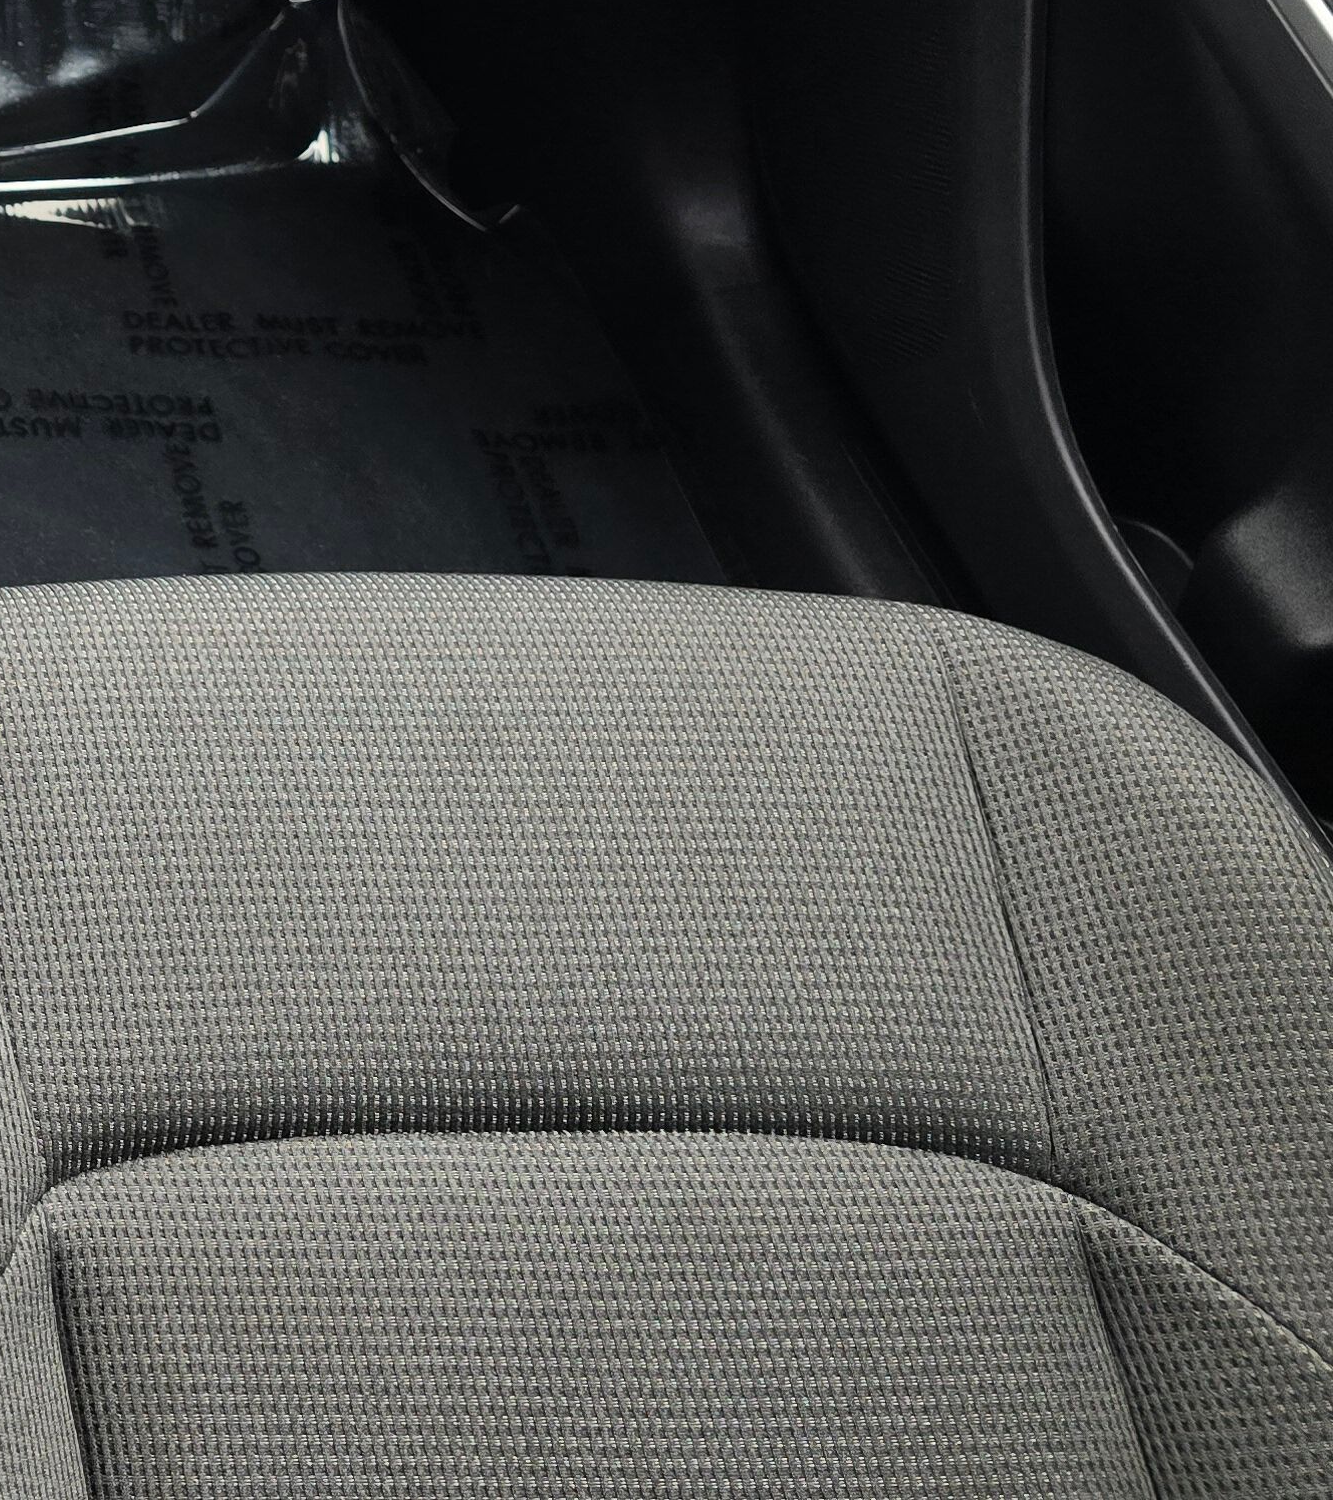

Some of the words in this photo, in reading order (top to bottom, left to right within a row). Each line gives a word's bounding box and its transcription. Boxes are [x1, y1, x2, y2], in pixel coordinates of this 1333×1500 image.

[123, 311, 235, 333] DEALER
[256, 312, 339, 336] MUST
[357, 317, 485, 342] REMOVE
[129, 335, 312, 360] PROTECTIVE
[324, 340, 428, 367] COVER
[27, 388, 215, 417] PROTECTIVE
[105, 417, 223, 443] DEALER
[161, 443, 219, 550] REMOVE
